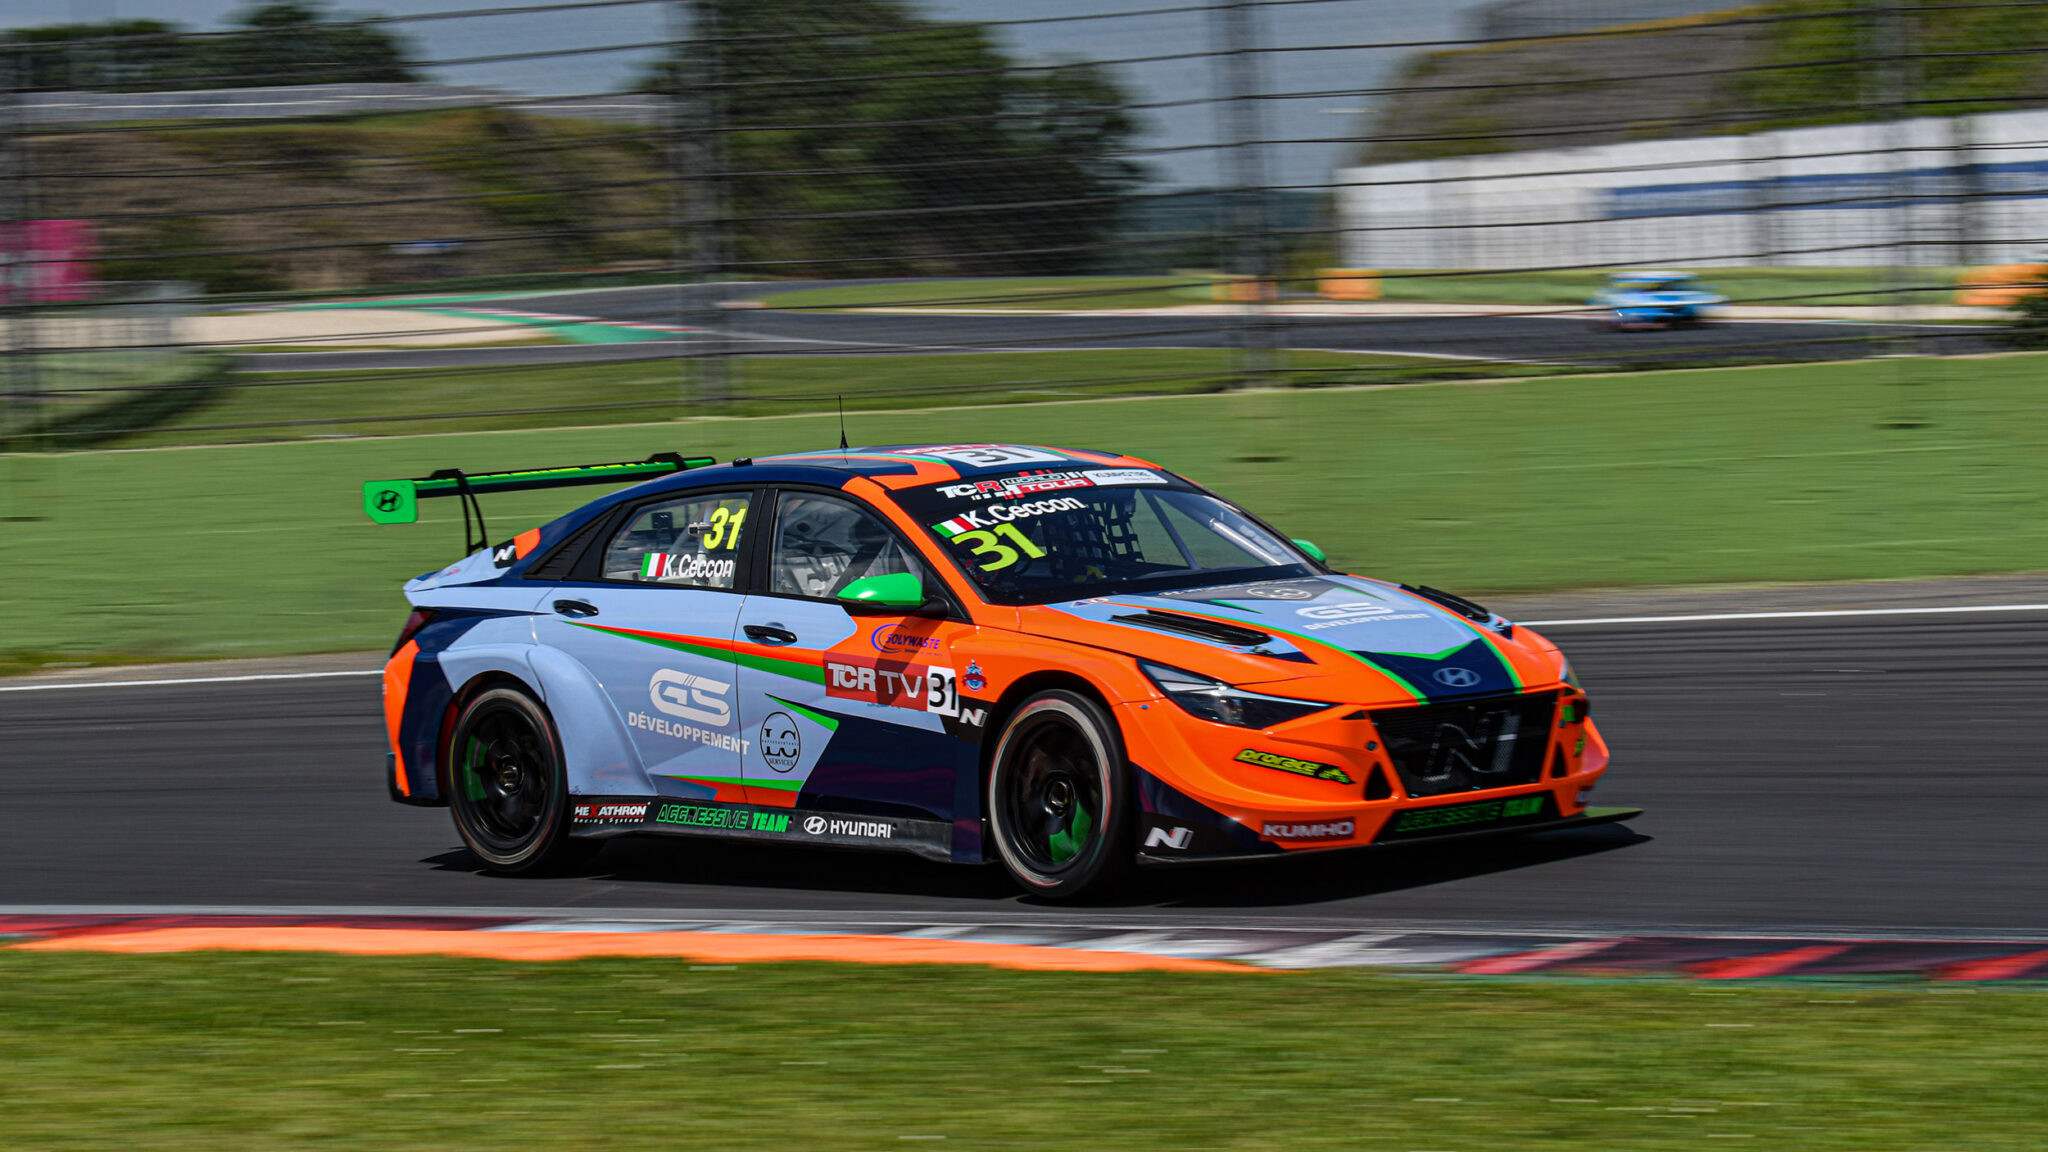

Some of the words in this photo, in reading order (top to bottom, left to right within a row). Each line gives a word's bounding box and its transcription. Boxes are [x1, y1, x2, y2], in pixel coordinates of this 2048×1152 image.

[936, 480, 1002, 499] TCR
[1005, 474, 1063, 485] WORLD
[1021, 479, 1089, 491] TOUR
[959, 497, 1086, 529] K.Ceccon
[703, 507, 747, 550] 31
[951, 523, 1046, 572] 31
[663, 554, 734, 578] K.Ceccon
[828, 662, 877, 692] TCR
[879, 670, 922, 699] TV
[929, 672, 957, 711] 31
[649, 668, 731, 727] GS
[628, 711, 750, 755] DÉVELOPPEMENT
[574, 804, 647, 817] HEXATHRON
[656, 804, 749, 829] AGGRESSIVE
[751, 812, 790, 833] TEAM
[830, 819, 892, 839] HYUNDAI
[1263, 821, 1354, 838] KUMHO
